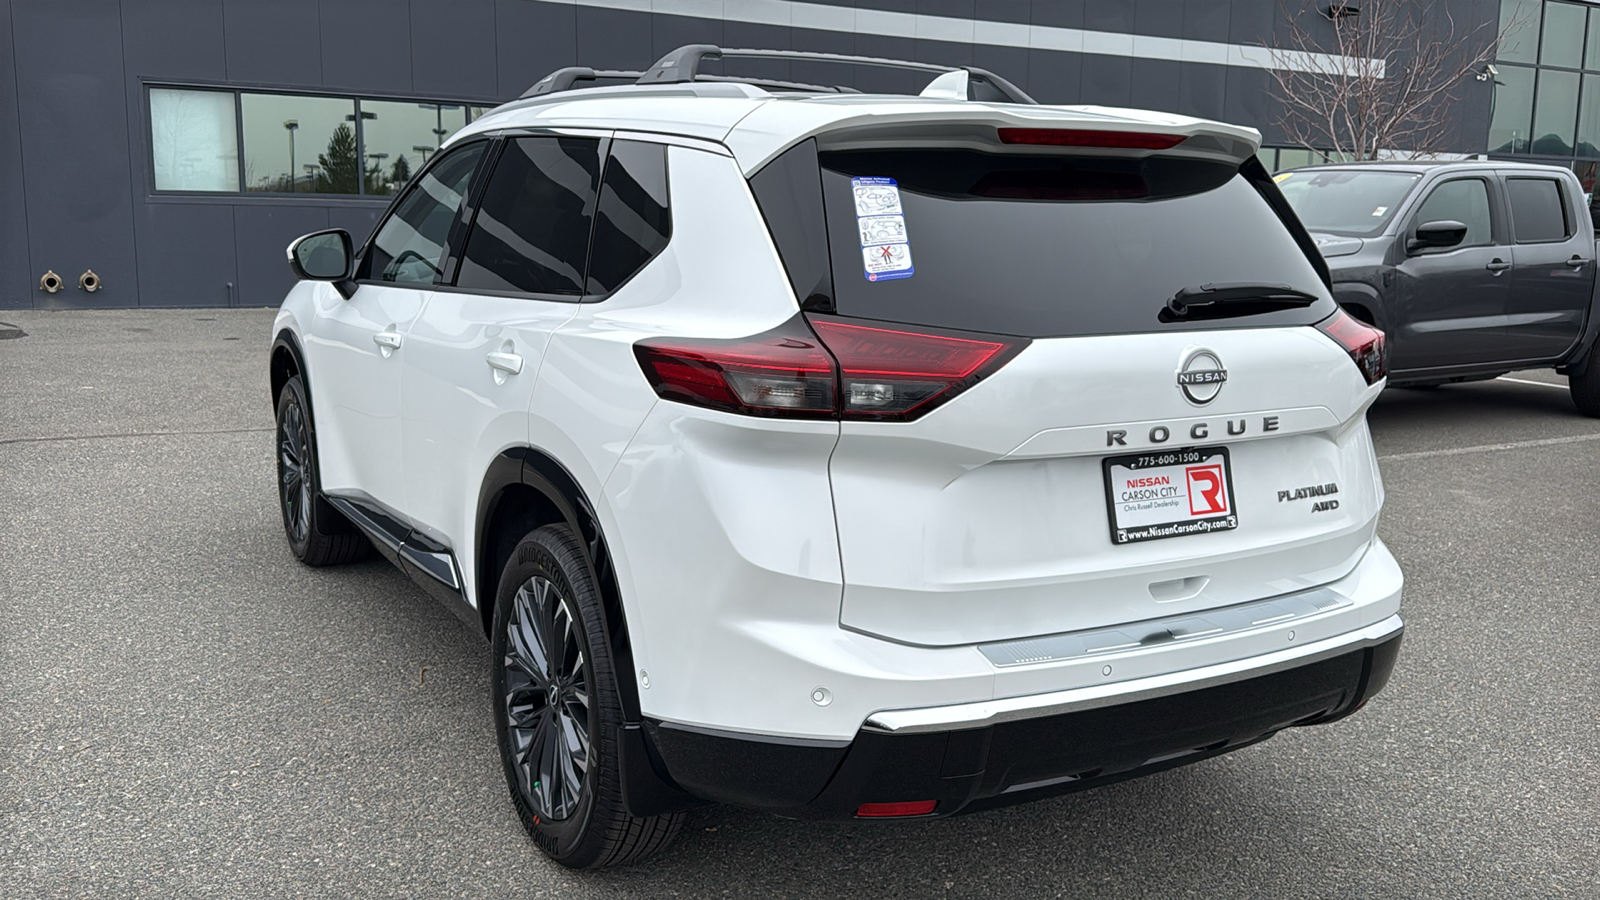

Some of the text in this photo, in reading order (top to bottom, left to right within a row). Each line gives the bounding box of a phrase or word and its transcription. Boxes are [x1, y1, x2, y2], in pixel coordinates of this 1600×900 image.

[1179, 371, 1228, 384] NISSAN
[1106, 415, 1280, 447] ROGUE
[1138, 451, 1200, 467] 775-600-1500
[1126, 475, 1171, 489] NISSAN
[1121, 486, 1178, 502] CARSON CITY
[1277, 482, 1339, 503] PLATINUM
[1123, 500, 1180, 512] Chris Russell Dealership
[1311, 499, 1340, 513] AWD
[1128, 519, 1228, 541] www.NissanCarsonCity.com
[518, 546, 568, 599] BRIDGESTONE
